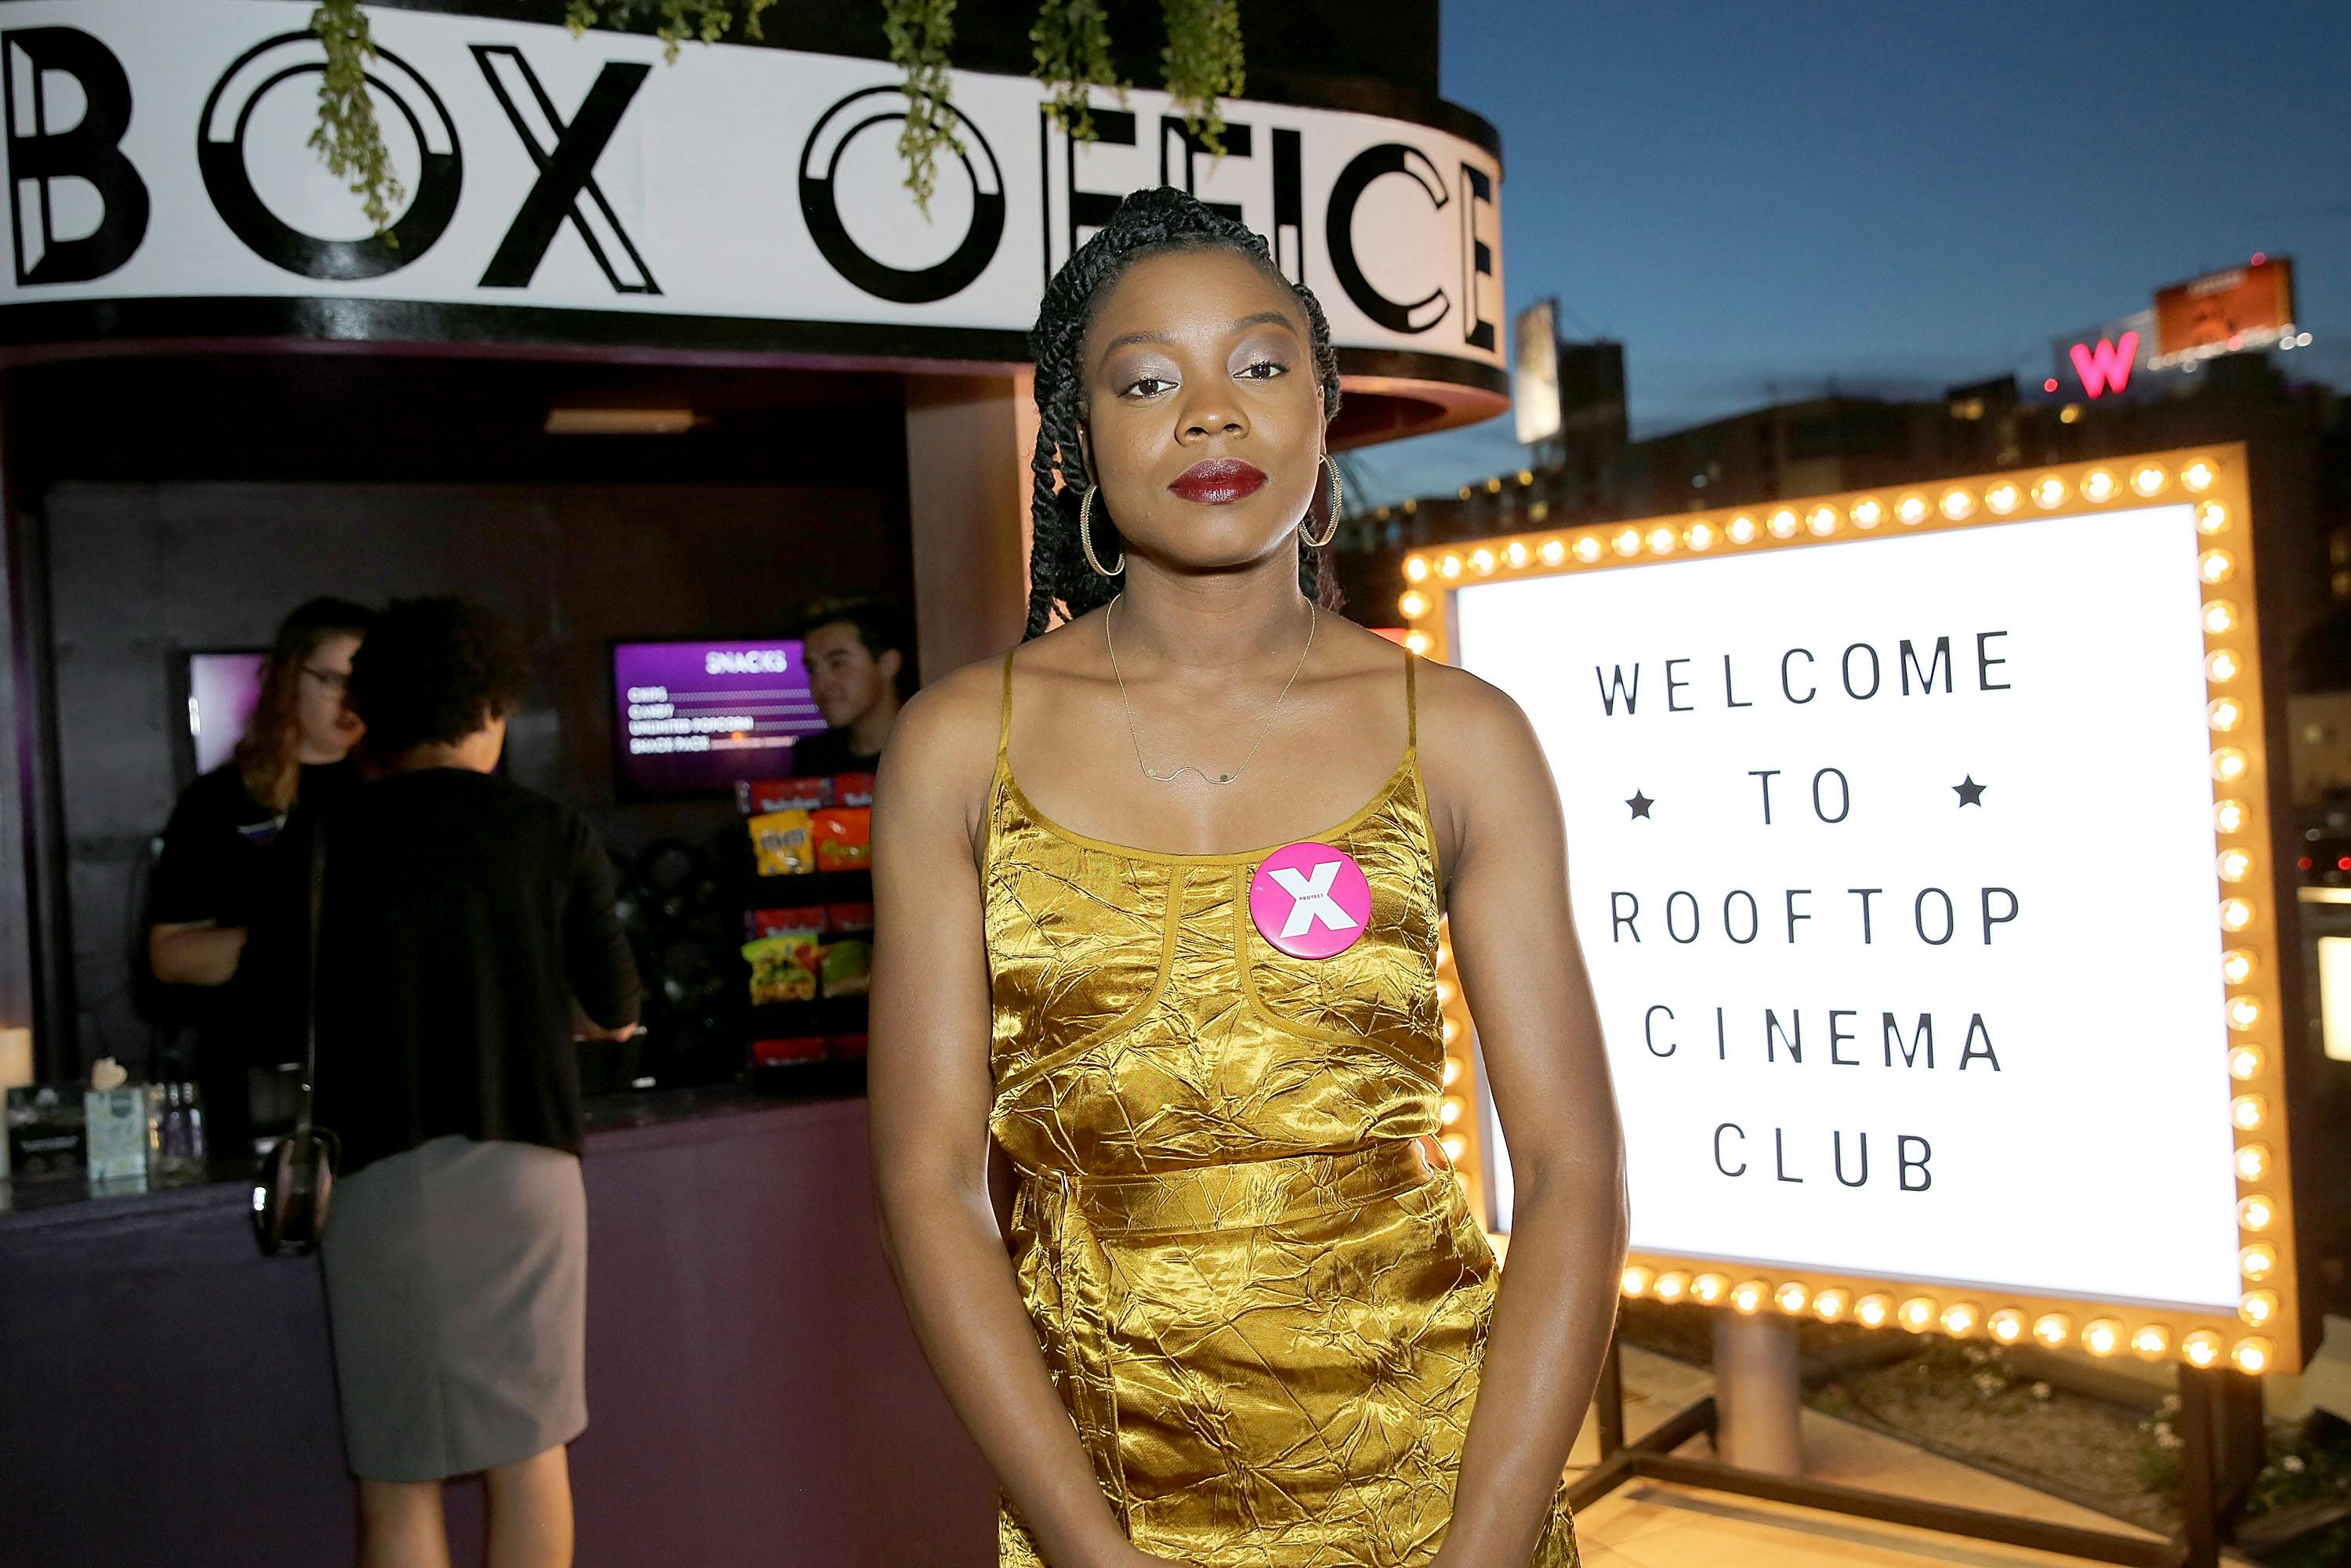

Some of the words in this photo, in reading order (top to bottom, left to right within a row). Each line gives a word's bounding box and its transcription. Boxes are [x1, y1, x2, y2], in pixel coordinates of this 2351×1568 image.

[2, 26, 664, 295] BOX
[2069, 331, 2140, 400] W
[1596, 630, 2011, 716] WELCOME
[1748, 767, 1849, 825] TO
[1266, 860, 1360, 939] X
[1610, 887, 2019, 946] ROOFTOP
[1645, 1005, 2001, 1072] CINEMA
[1714, 1123, 1932, 1192] CLUB
